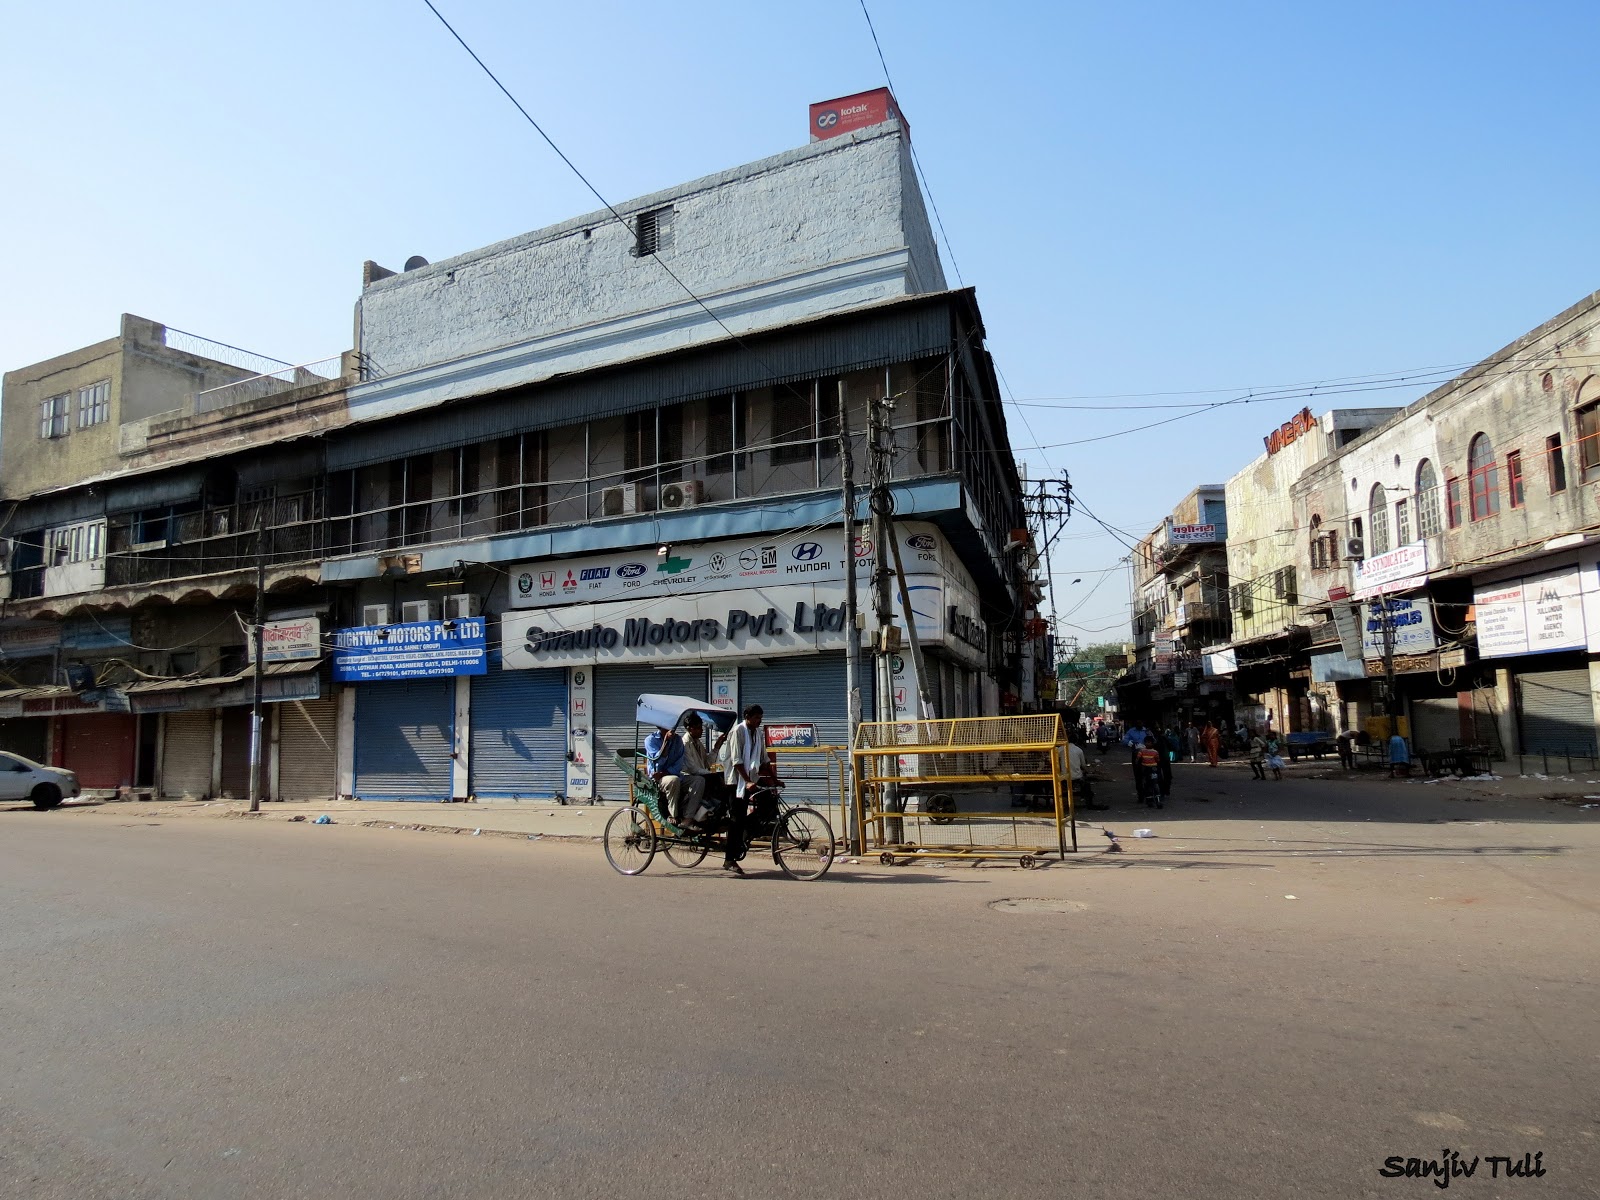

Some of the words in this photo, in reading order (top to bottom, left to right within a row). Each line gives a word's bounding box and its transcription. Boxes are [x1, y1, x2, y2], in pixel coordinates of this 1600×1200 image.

[841, 104, 868, 117] kotak
[1263, 406, 1317, 458] MINERVA
[761, 550, 777, 565] GM
[840, 558, 876, 569] TYOTA
[1372, 549, 1409, 572] SYNDICATE
[622, 566, 642, 577] Ford
[786, 561, 830, 574] HYUNDAI
[581, 568, 610, 580] FIAT
[623, 580, 641, 588] FORD
[653, 576, 696, 586] CHEVROLET
[1384, 580, 1412, 592] SYNDICATE
[1536, 604, 1563, 615] JULLUNDUR
[1545, 613, 1563, 622] MOTOR
[388, 626, 431, 644] MOTORS
[461, 621, 484, 639] LTD.
[524, 623, 618, 653] Swauto
[623, 617, 719, 648] Motors
[726, 608, 784, 640] Pvt.
[1544, 622, 1562, 631] AGENCY
[767, 725, 789, 738] दिल्ली
[789, 725, 812, 739] पुलिस
